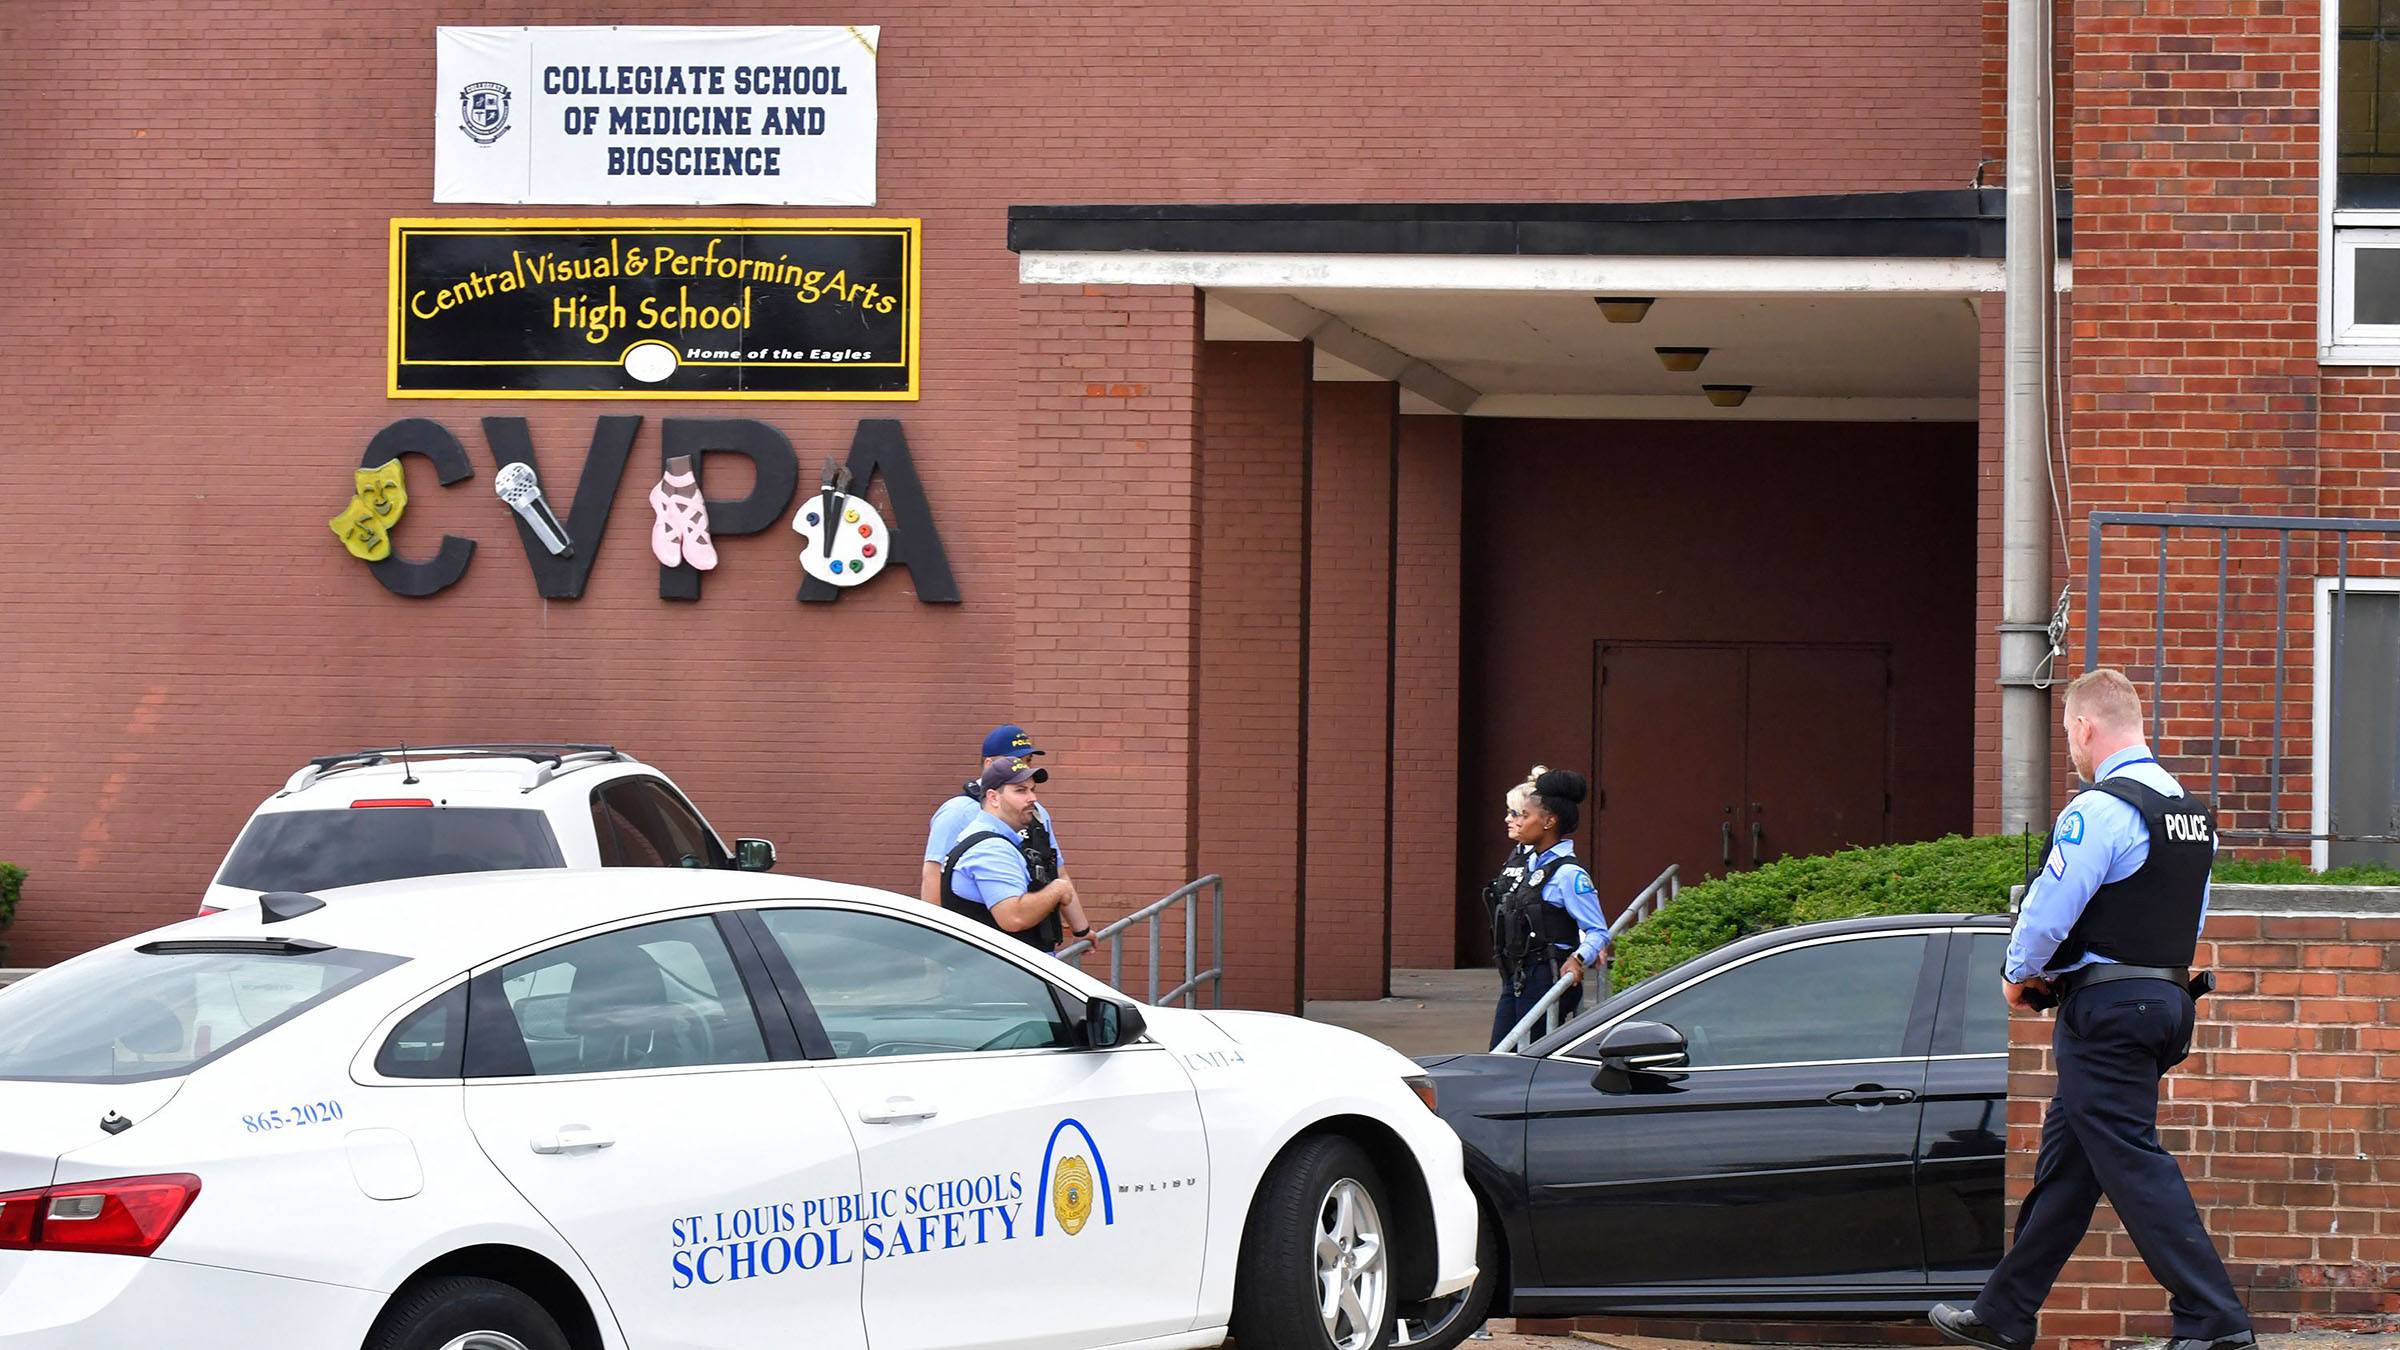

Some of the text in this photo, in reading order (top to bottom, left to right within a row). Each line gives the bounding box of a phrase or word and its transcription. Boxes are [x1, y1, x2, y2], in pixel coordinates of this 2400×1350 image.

[543, 66, 848, 95] COLLEGIATE SCHOOL
[564, 106, 826, 136] OF MEDICINE AND
[607, 146, 781, 176] BIOSCIENCE
[411, 237, 897, 320] Central Visual & Performing Arts
[553, 285, 751, 344] High School
[686, 348, 872, 363] Home of the Eagles
[358, 415, 962, 604] CVPA
[2164, 812, 2210, 842] POLICE
[242, 1099, 343, 1133] 865-2020
[1118, 1177, 1196, 1193] MALIBU
[672, 1215, 708, 1247] ST.
[715, 1202, 796, 1241] LOUIS
[802, 1189, 897, 1229] PUBLIC
[904, 1171, 1023, 1215] SCHOOLS
[672, 1202, 1024, 1290] SCHOOL SAFETY
